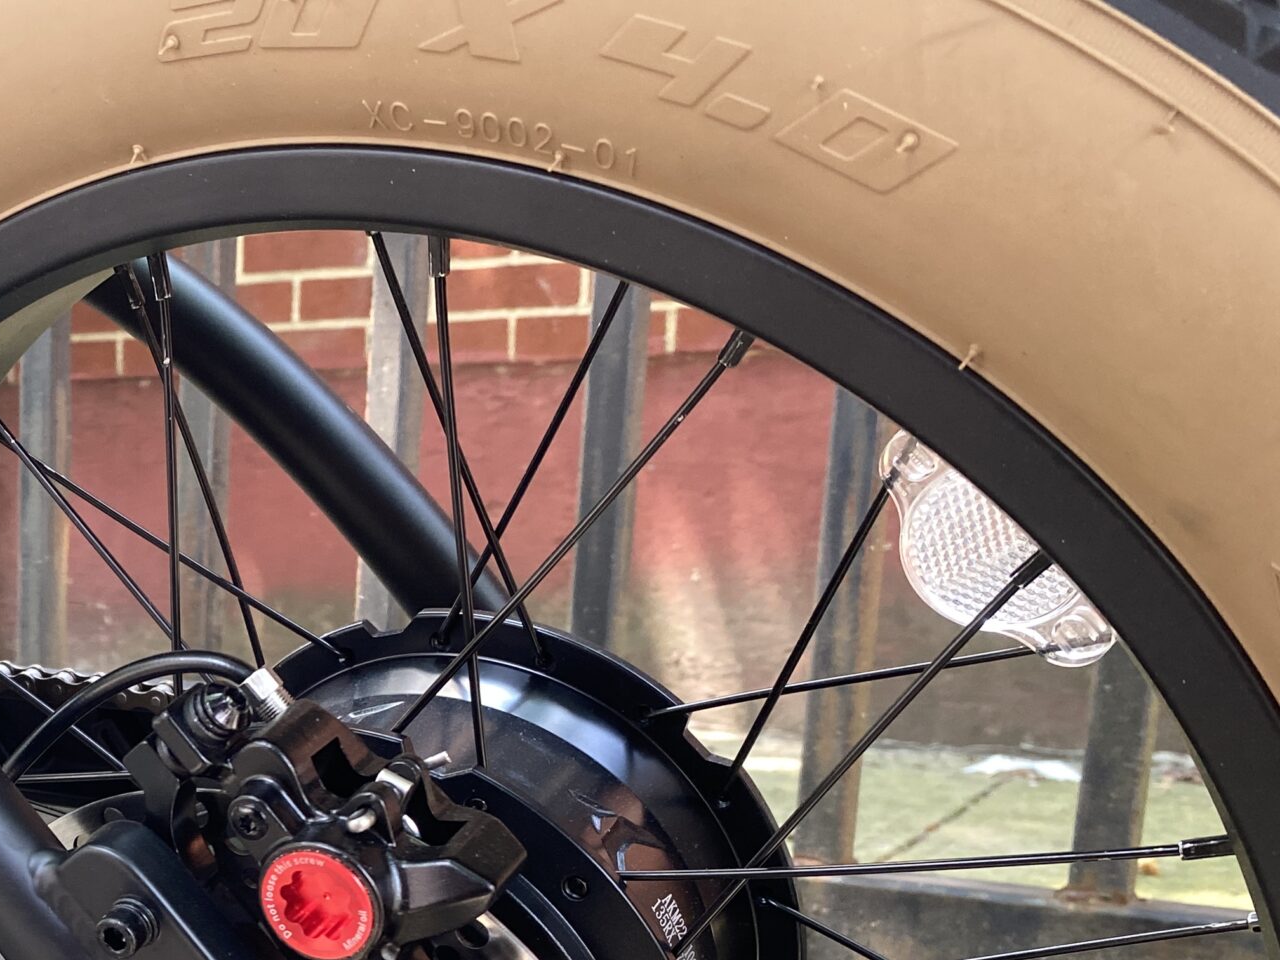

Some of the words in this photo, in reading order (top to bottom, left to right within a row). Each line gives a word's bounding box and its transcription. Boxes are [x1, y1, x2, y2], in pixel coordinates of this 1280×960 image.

[599, 13, 960, 194] 4.0
[362, 98, 641, 179] XC-9002-01
[273, 860, 293, 875] this
[293, 857, 326, 867] screw
[263, 873, 279, 902] loose
[266, 903, 281, 922] not
[278, 923, 293, 940] Do
[342, 920, 368, 951] Mineral
[357, 909, 369, 922] oil
